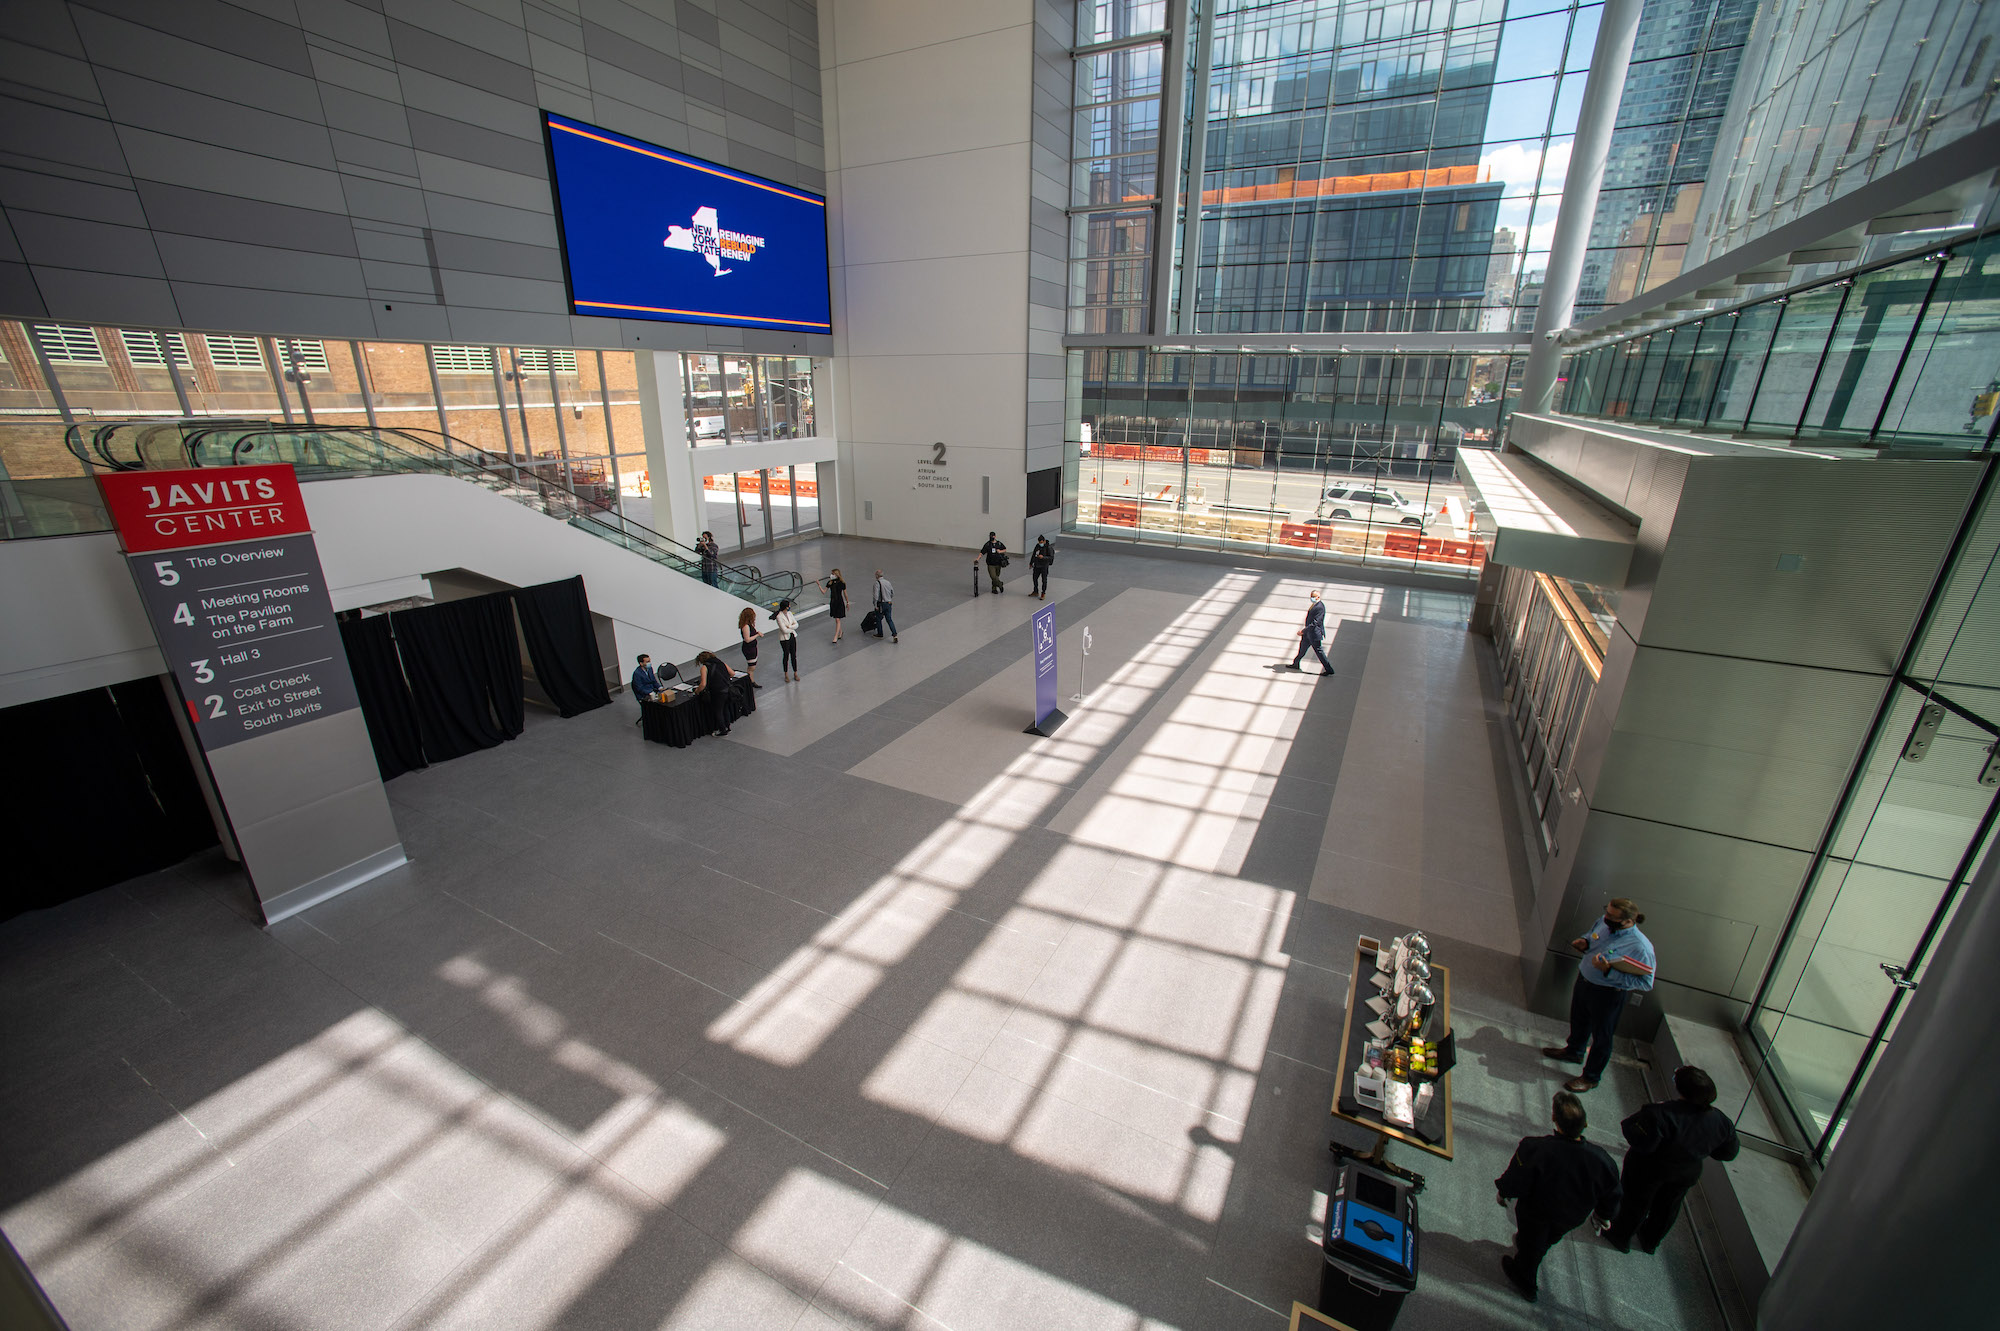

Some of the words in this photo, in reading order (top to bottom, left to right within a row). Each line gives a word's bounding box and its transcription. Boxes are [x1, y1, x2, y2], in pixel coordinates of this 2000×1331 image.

[692, 224, 712, 236] NEW
[692, 234, 717, 247] YORK
[719, 228, 765, 248] REIMAGINE
[693, 243, 720, 256] STATE
[720, 239, 756, 254] REBUILD
[720, 248, 751, 262] RENEW
[933, 442, 947, 466] 2
[142, 478, 275, 508] JAVITS
[154, 508, 285, 535] CENTER
[154, 560, 180, 586] 5
[186, 557, 217, 569] The
[220, 548, 284, 564] Overview
[201, 593, 260, 610] Meeting
[262, 584, 310, 599] Rooms
[173, 602, 195, 627] 4
[206, 614, 236, 626] The
[238, 604, 292, 621] Pavilion
[212, 628, 231, 639] on
[233, 623, 256, 635] the
[259, 616, 294, 630] Farm
[190, 659, 215, 684] 3
[220, 651, 248, 666] Hall
[250, 648, 261, 659] 3
[233, 683, 267, 700] Coat
[269, 673, 311, 690] Check
[204, 694, 228, 720] 2
[238, 701, 265, 715] Exit
[267, 698, 281, 707] to
[283, 686, 322, 703] Street
[243, 713, 283, 731] South
[286, 702, 322, 719] Javits
